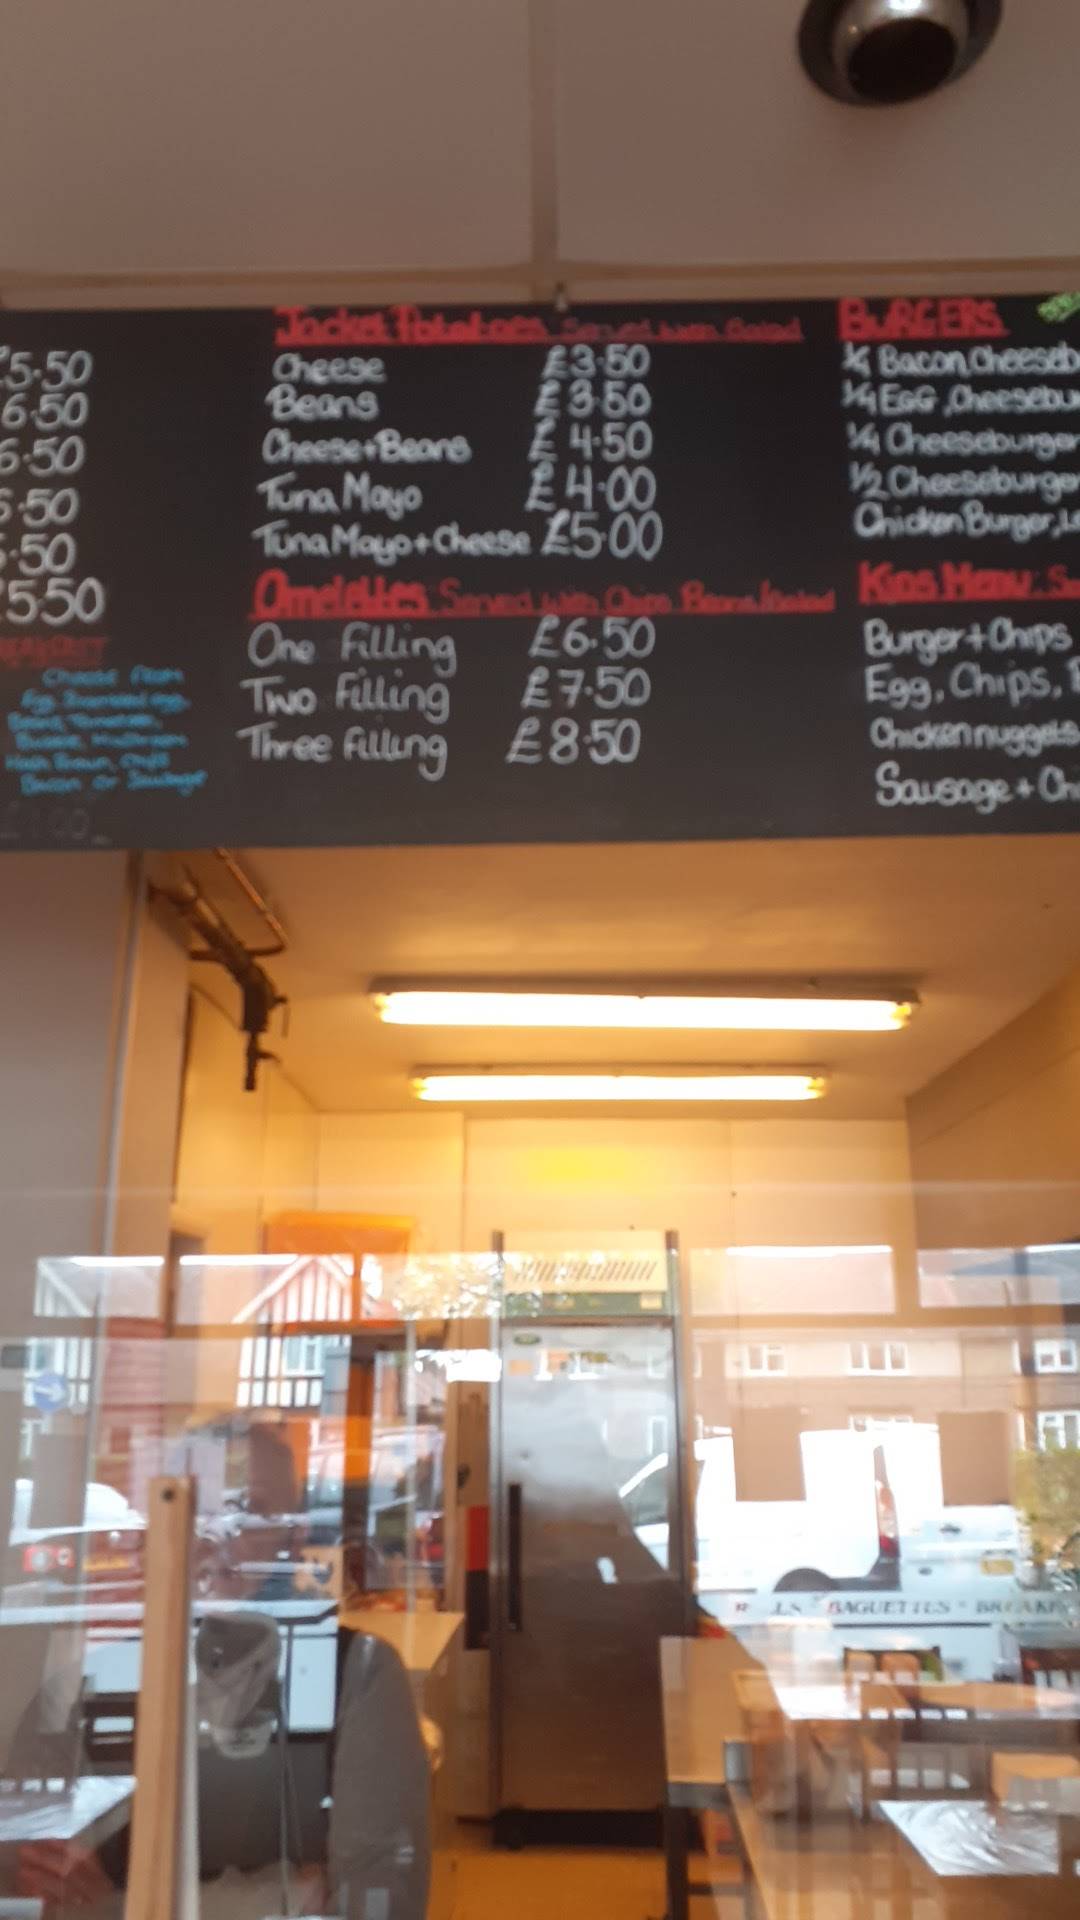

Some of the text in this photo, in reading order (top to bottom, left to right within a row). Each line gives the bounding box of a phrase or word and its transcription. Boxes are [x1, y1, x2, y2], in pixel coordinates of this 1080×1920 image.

[272, 352, 387, 385] Cheese
[265, 383, 379, 421] Beans
[256, 471, 341, 514] Tuna
[342, 471, 424, 521] Mayo
[0, 576, 106, 625] 5.50
[248, 621, 316, 668] One
[527, 613, 656, 660] £6.50
[239, 674, 318, 716] Two
[520, 665, 652, 710] £7.50
[235, 720, 334, 763] Three
[504, 716, 642, 765] £8.50
[875, 760, 1014, 815] Sausage
